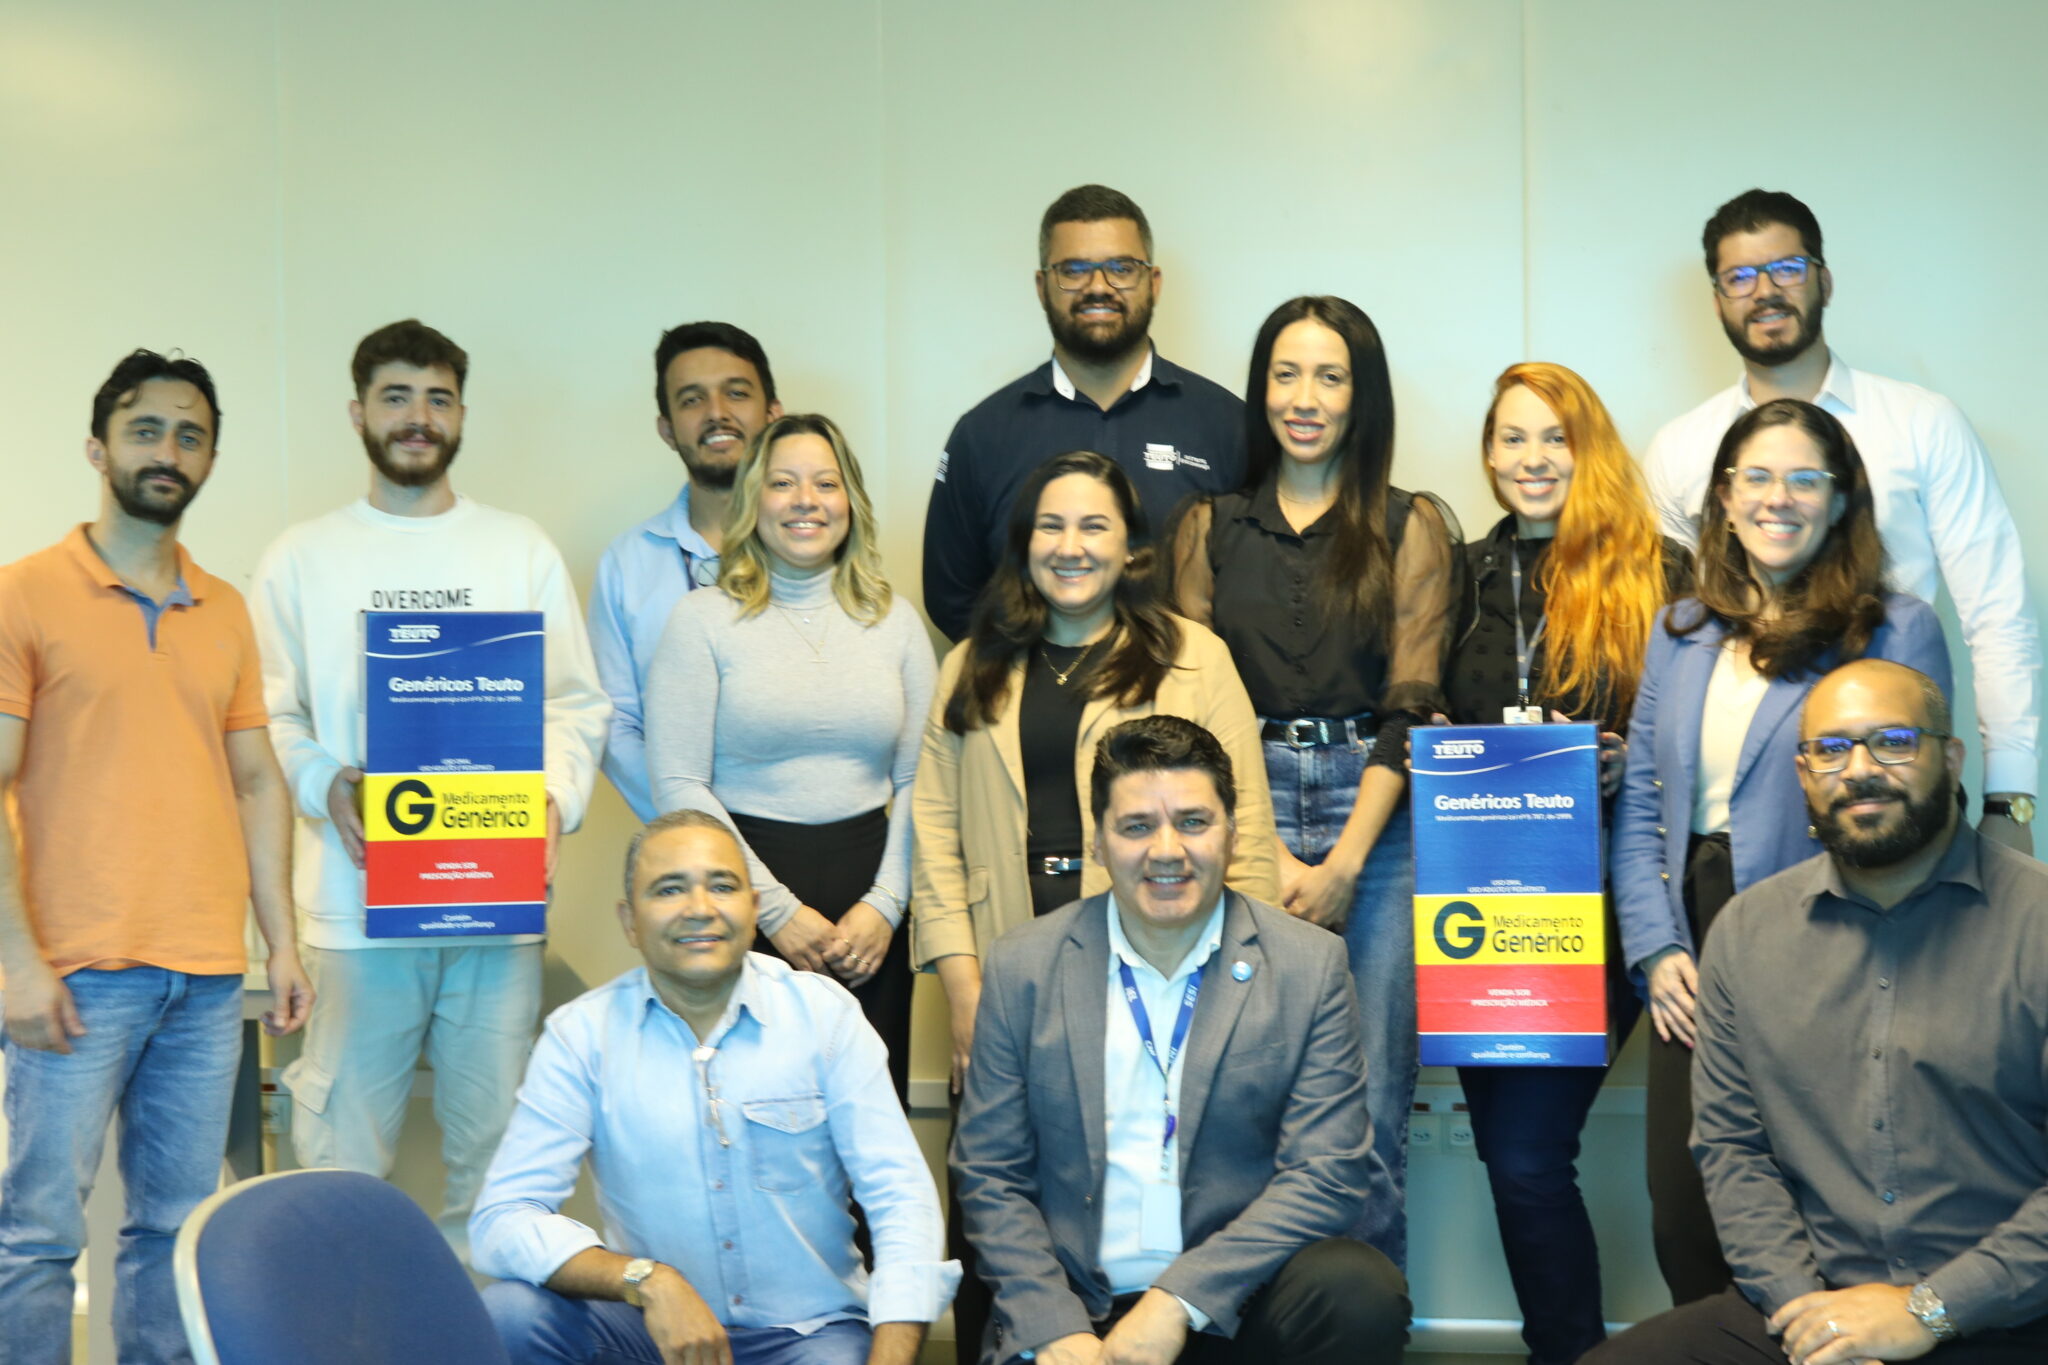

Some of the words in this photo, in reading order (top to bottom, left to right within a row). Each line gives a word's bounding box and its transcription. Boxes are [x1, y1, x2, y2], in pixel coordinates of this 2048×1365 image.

[371, 588, 473, 609] OVERCOME
[388, 627, 441, 641] TEUTO
[388, 676, 474, 693] Genéricos
[475, 676, 525, 692] Teuto
[1432, 743, 1485, 756] TEUTO
[386, 779, 435, 835] G
[442, 792, 530, 806] Medicamento
[1434, 793, 1522, 811] Genéricos
[1523, 793, 1575, 809] Teuto
[441, 806, 530, 828] Genérico
[1433, 901, 1486, 960] G
[1493, 915, 1584, 928] Medicamento
[1492, 929, 1585, 953] Genérico
[1183, 983, 1198, 1009] SESI
